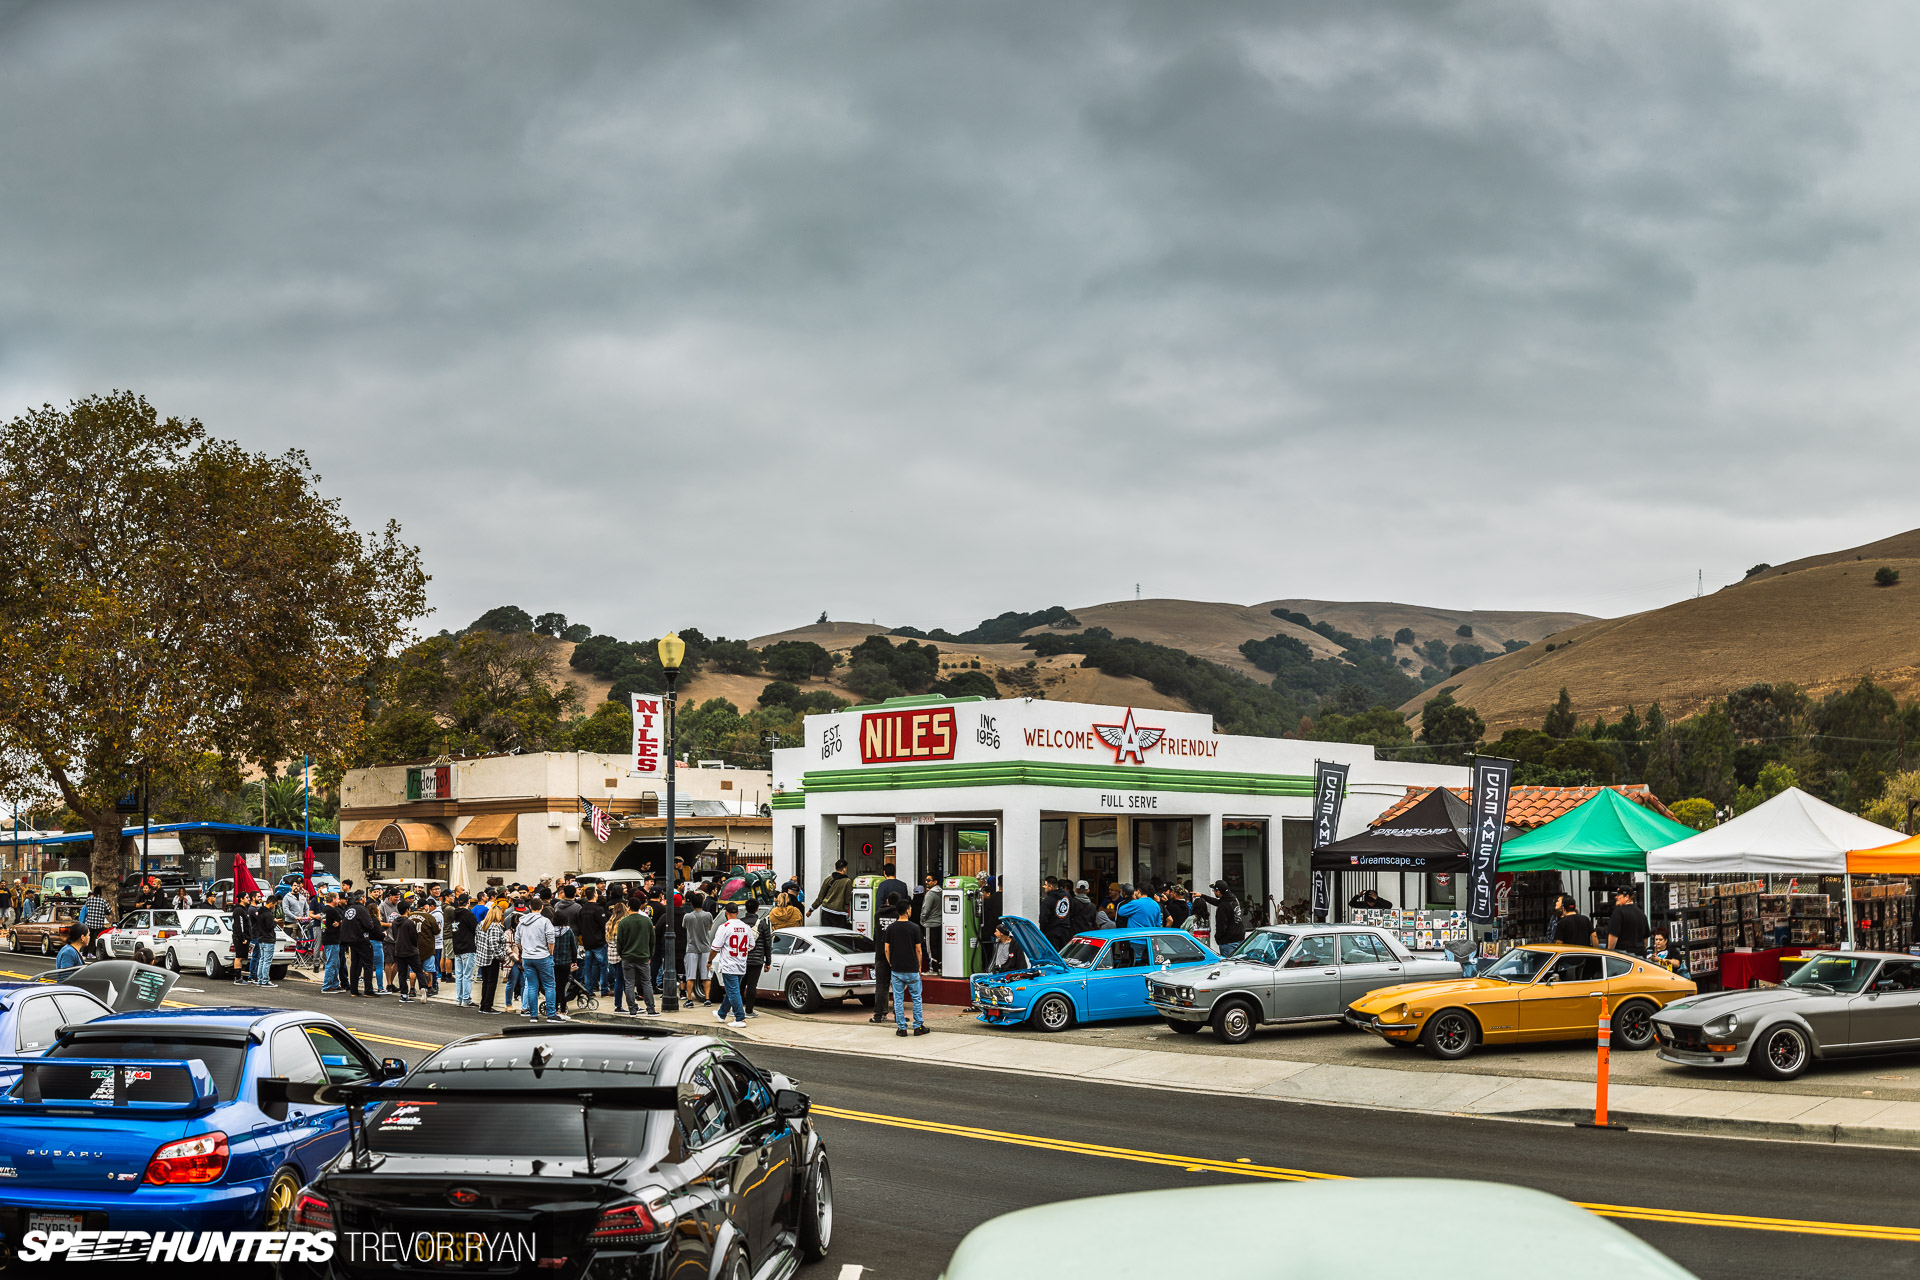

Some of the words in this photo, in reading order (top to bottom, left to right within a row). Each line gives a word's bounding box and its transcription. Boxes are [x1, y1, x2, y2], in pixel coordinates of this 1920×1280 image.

[823, 724, 841, 744] EST.
[980, 713, 998, 733] INC.
[636, 700, 658, 772] NILES
[865, 713, 951, 759] NILES
[976, 728, 1001, 750] 1956
[1023, 727, 1095, 749] WELCOME
[1160, 737, 1219, 758] FRIENDLY
[821, 738, 843, 760] 1870
[1101, 794, 1124, 808] FULL
[1128, 795, 1158, 809] SERVE
[1360, 855, 1426, 867] dreamscape_cc
[729, 934, 748, 958] 94
[26, 1149, 103, 1158] SUBARU
